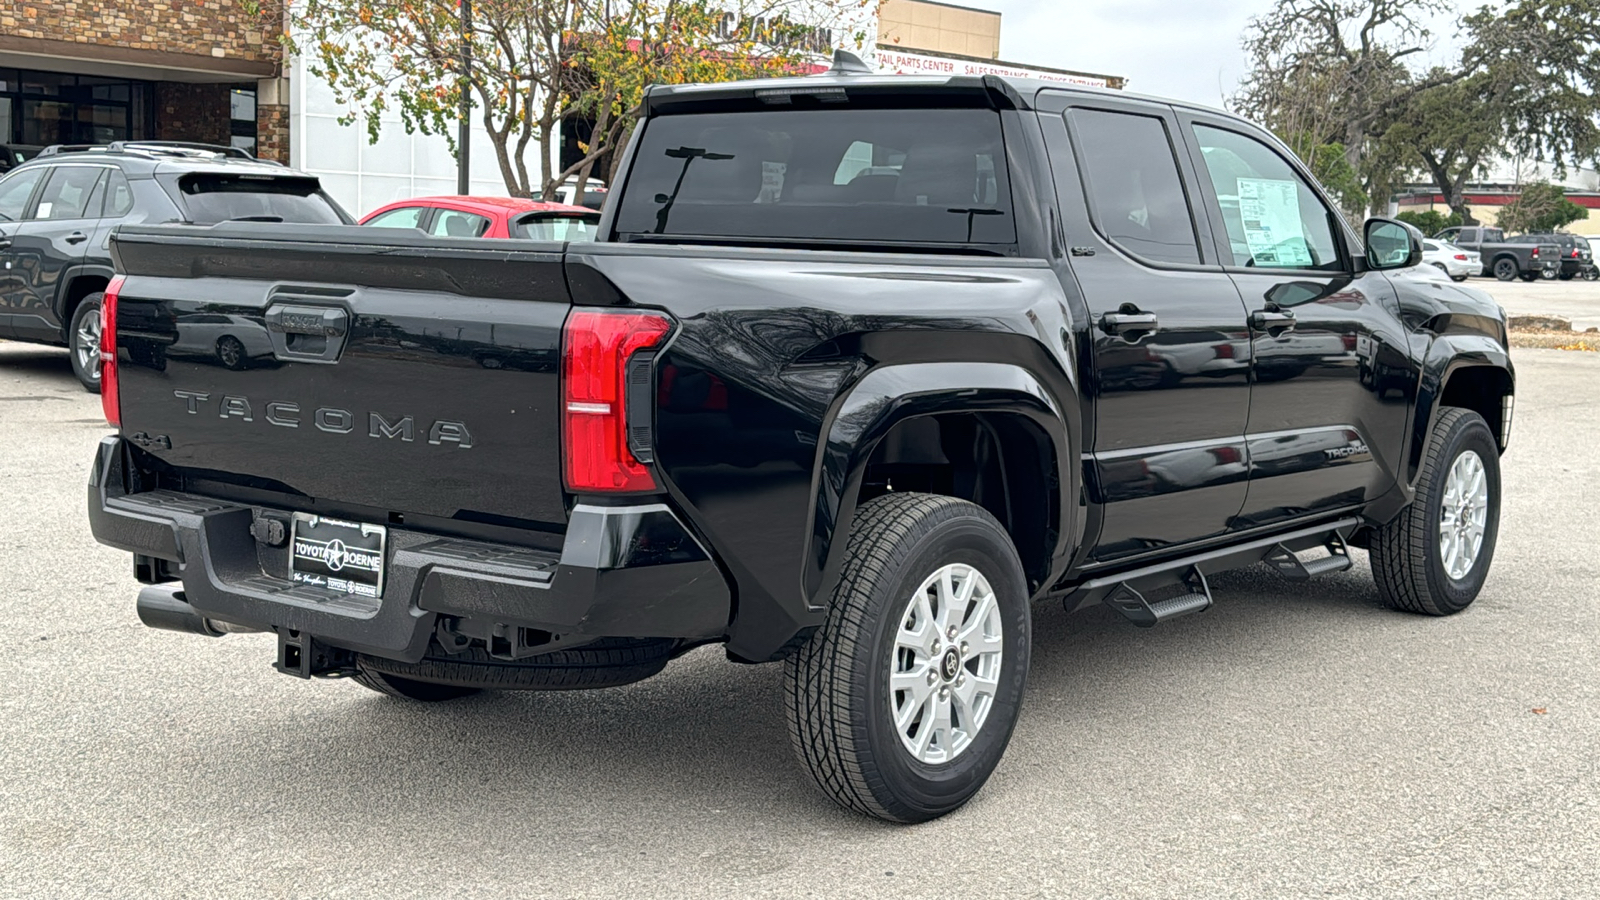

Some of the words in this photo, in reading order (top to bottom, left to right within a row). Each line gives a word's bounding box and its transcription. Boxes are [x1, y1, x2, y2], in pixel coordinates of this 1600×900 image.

[877, 53, 894, 65] TAIL
[896, 56, 921, 69] PARTS
[922, 60, 954, 73] CENTER
[965, 65, 988, 75] SALES
[173, 389, 474, 449] TACOMA
[1324, 445, 1370, 459] TACOMA
[295, 543, 329, 559] TOYOTA
[343, 552, 380, 567] BOERNE
[327, 580, 346, 590] TOYOTA
